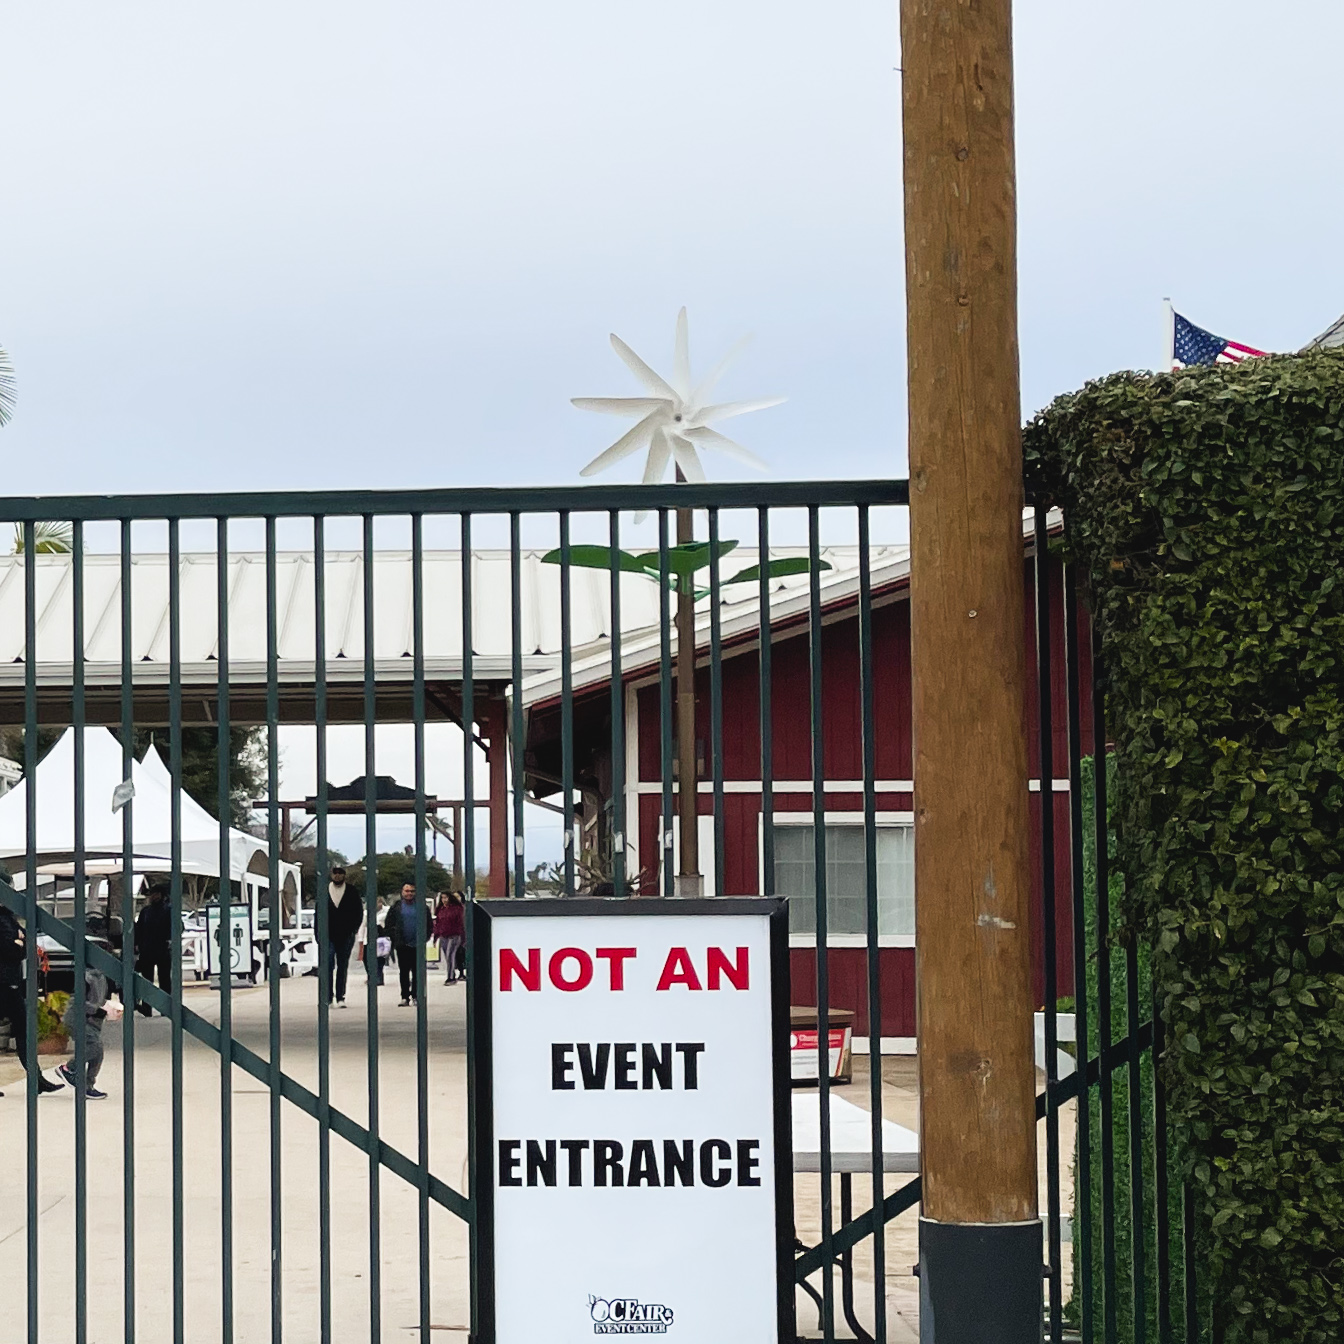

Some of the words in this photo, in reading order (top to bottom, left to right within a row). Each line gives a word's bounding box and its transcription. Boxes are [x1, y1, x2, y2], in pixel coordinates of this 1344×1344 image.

[498, 946, 637, 992] NOT
[655, 946, 750, 992] AN
[550, 1042, 705, 1090] EVENT
[498, 1138, 762, 1187] ENTRANCE
